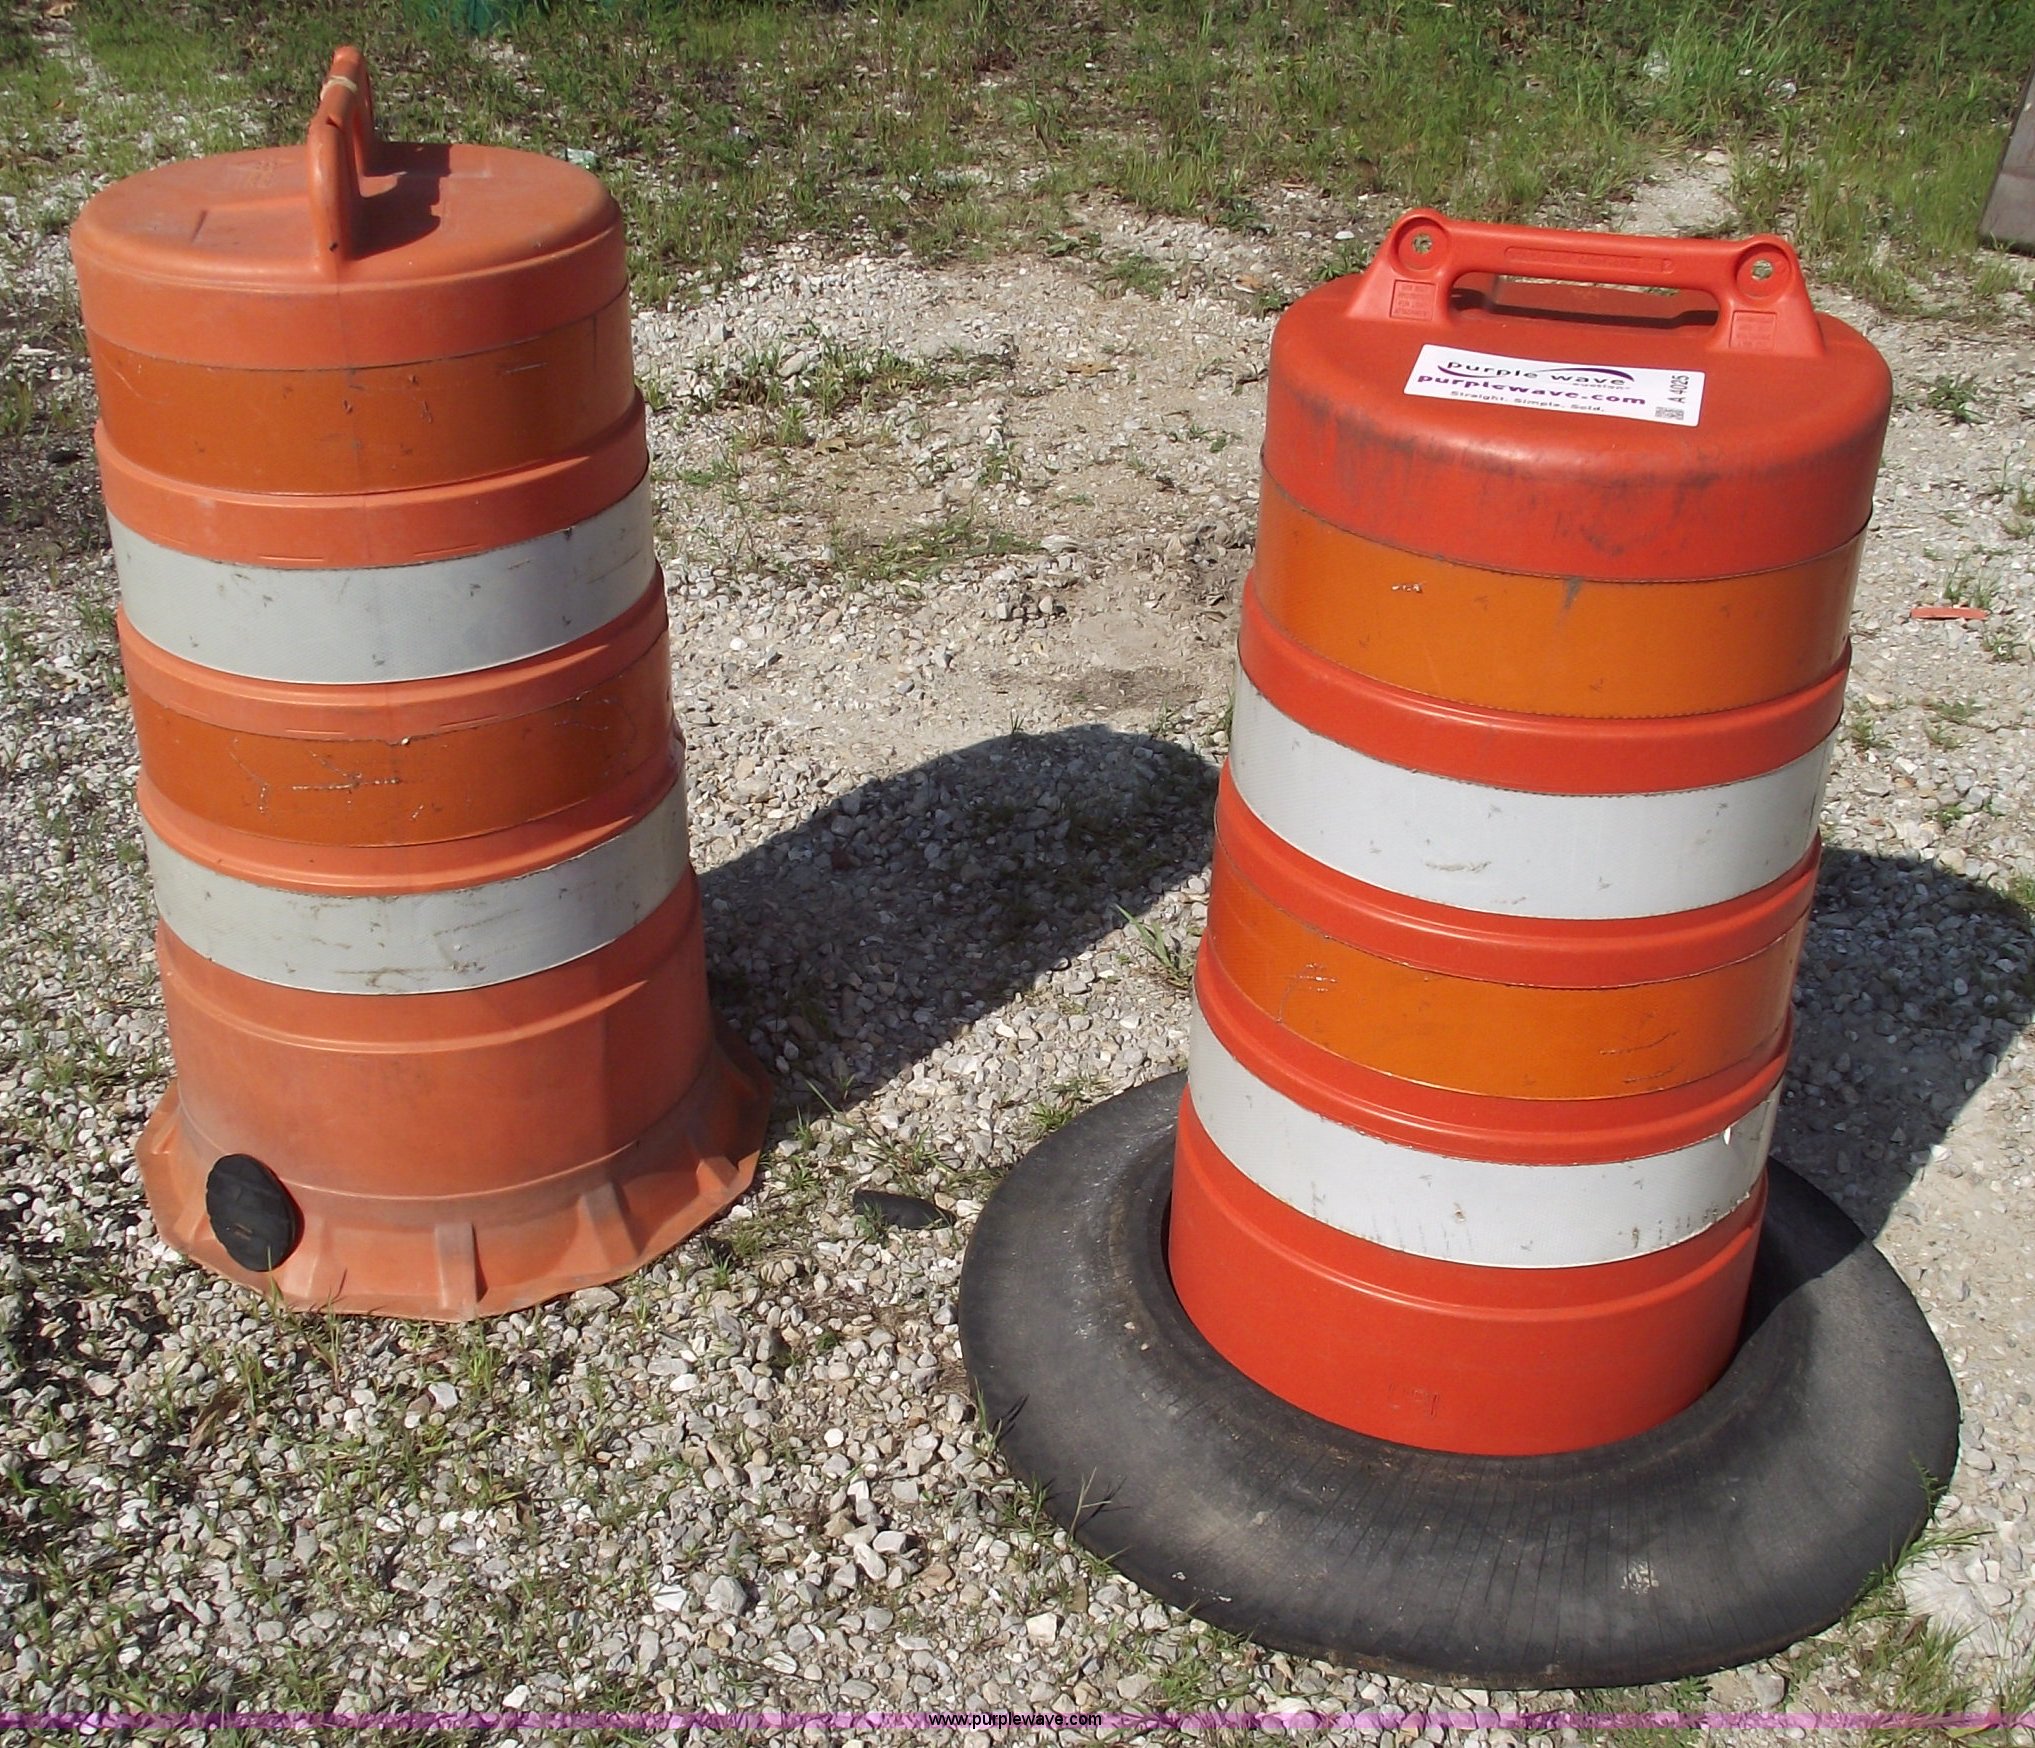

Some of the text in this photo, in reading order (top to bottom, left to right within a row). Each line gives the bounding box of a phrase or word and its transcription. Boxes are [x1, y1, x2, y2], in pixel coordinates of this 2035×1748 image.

[1447, 361, 1625, 386] purple wave
[1417, 375, 1646, 405] purplewave.com
